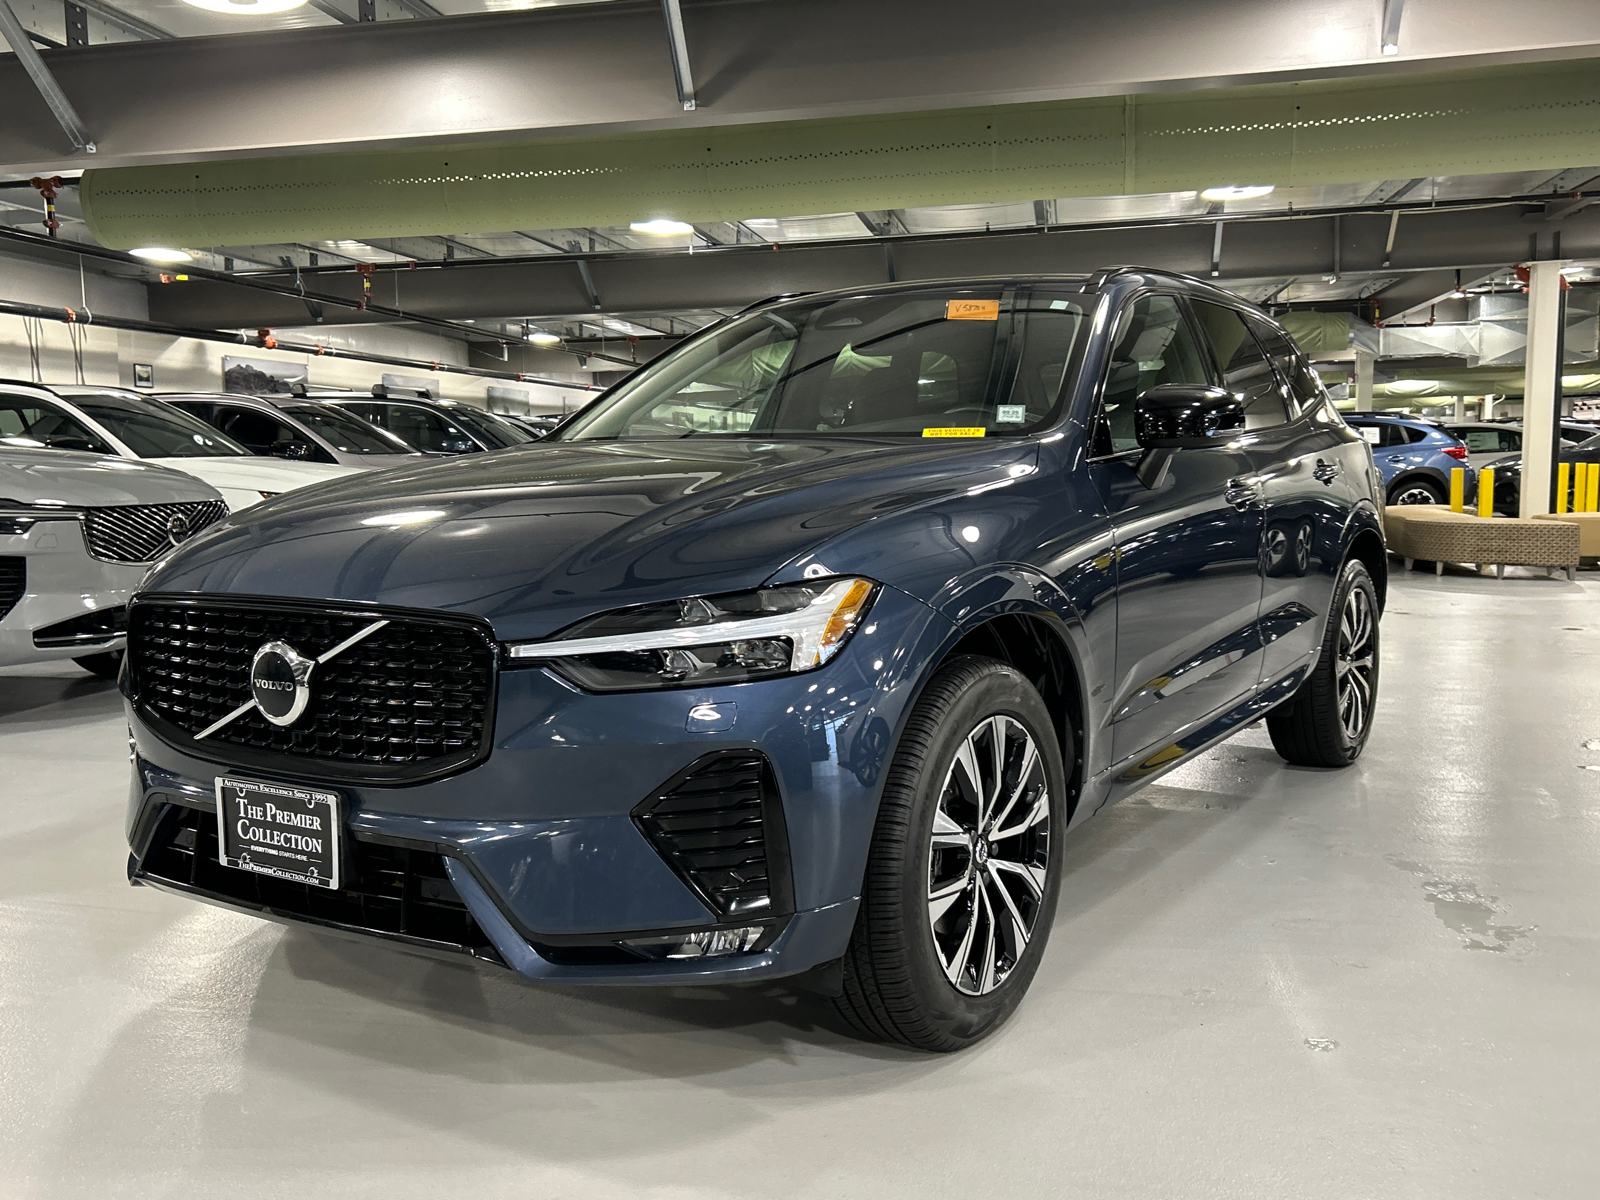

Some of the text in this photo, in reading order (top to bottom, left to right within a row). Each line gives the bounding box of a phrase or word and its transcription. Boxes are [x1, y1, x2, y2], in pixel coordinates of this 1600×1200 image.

[254, 678, 294, 692] VOLVO
[311, 793, 328, 803] 1995
[236, 797, 322, 831] THE PREMIER
[236, 818, 322, 853] COLLECTION
[250, 845, 278, 856] EVERYTHING
[278, 850, 295, 859] STARTS
